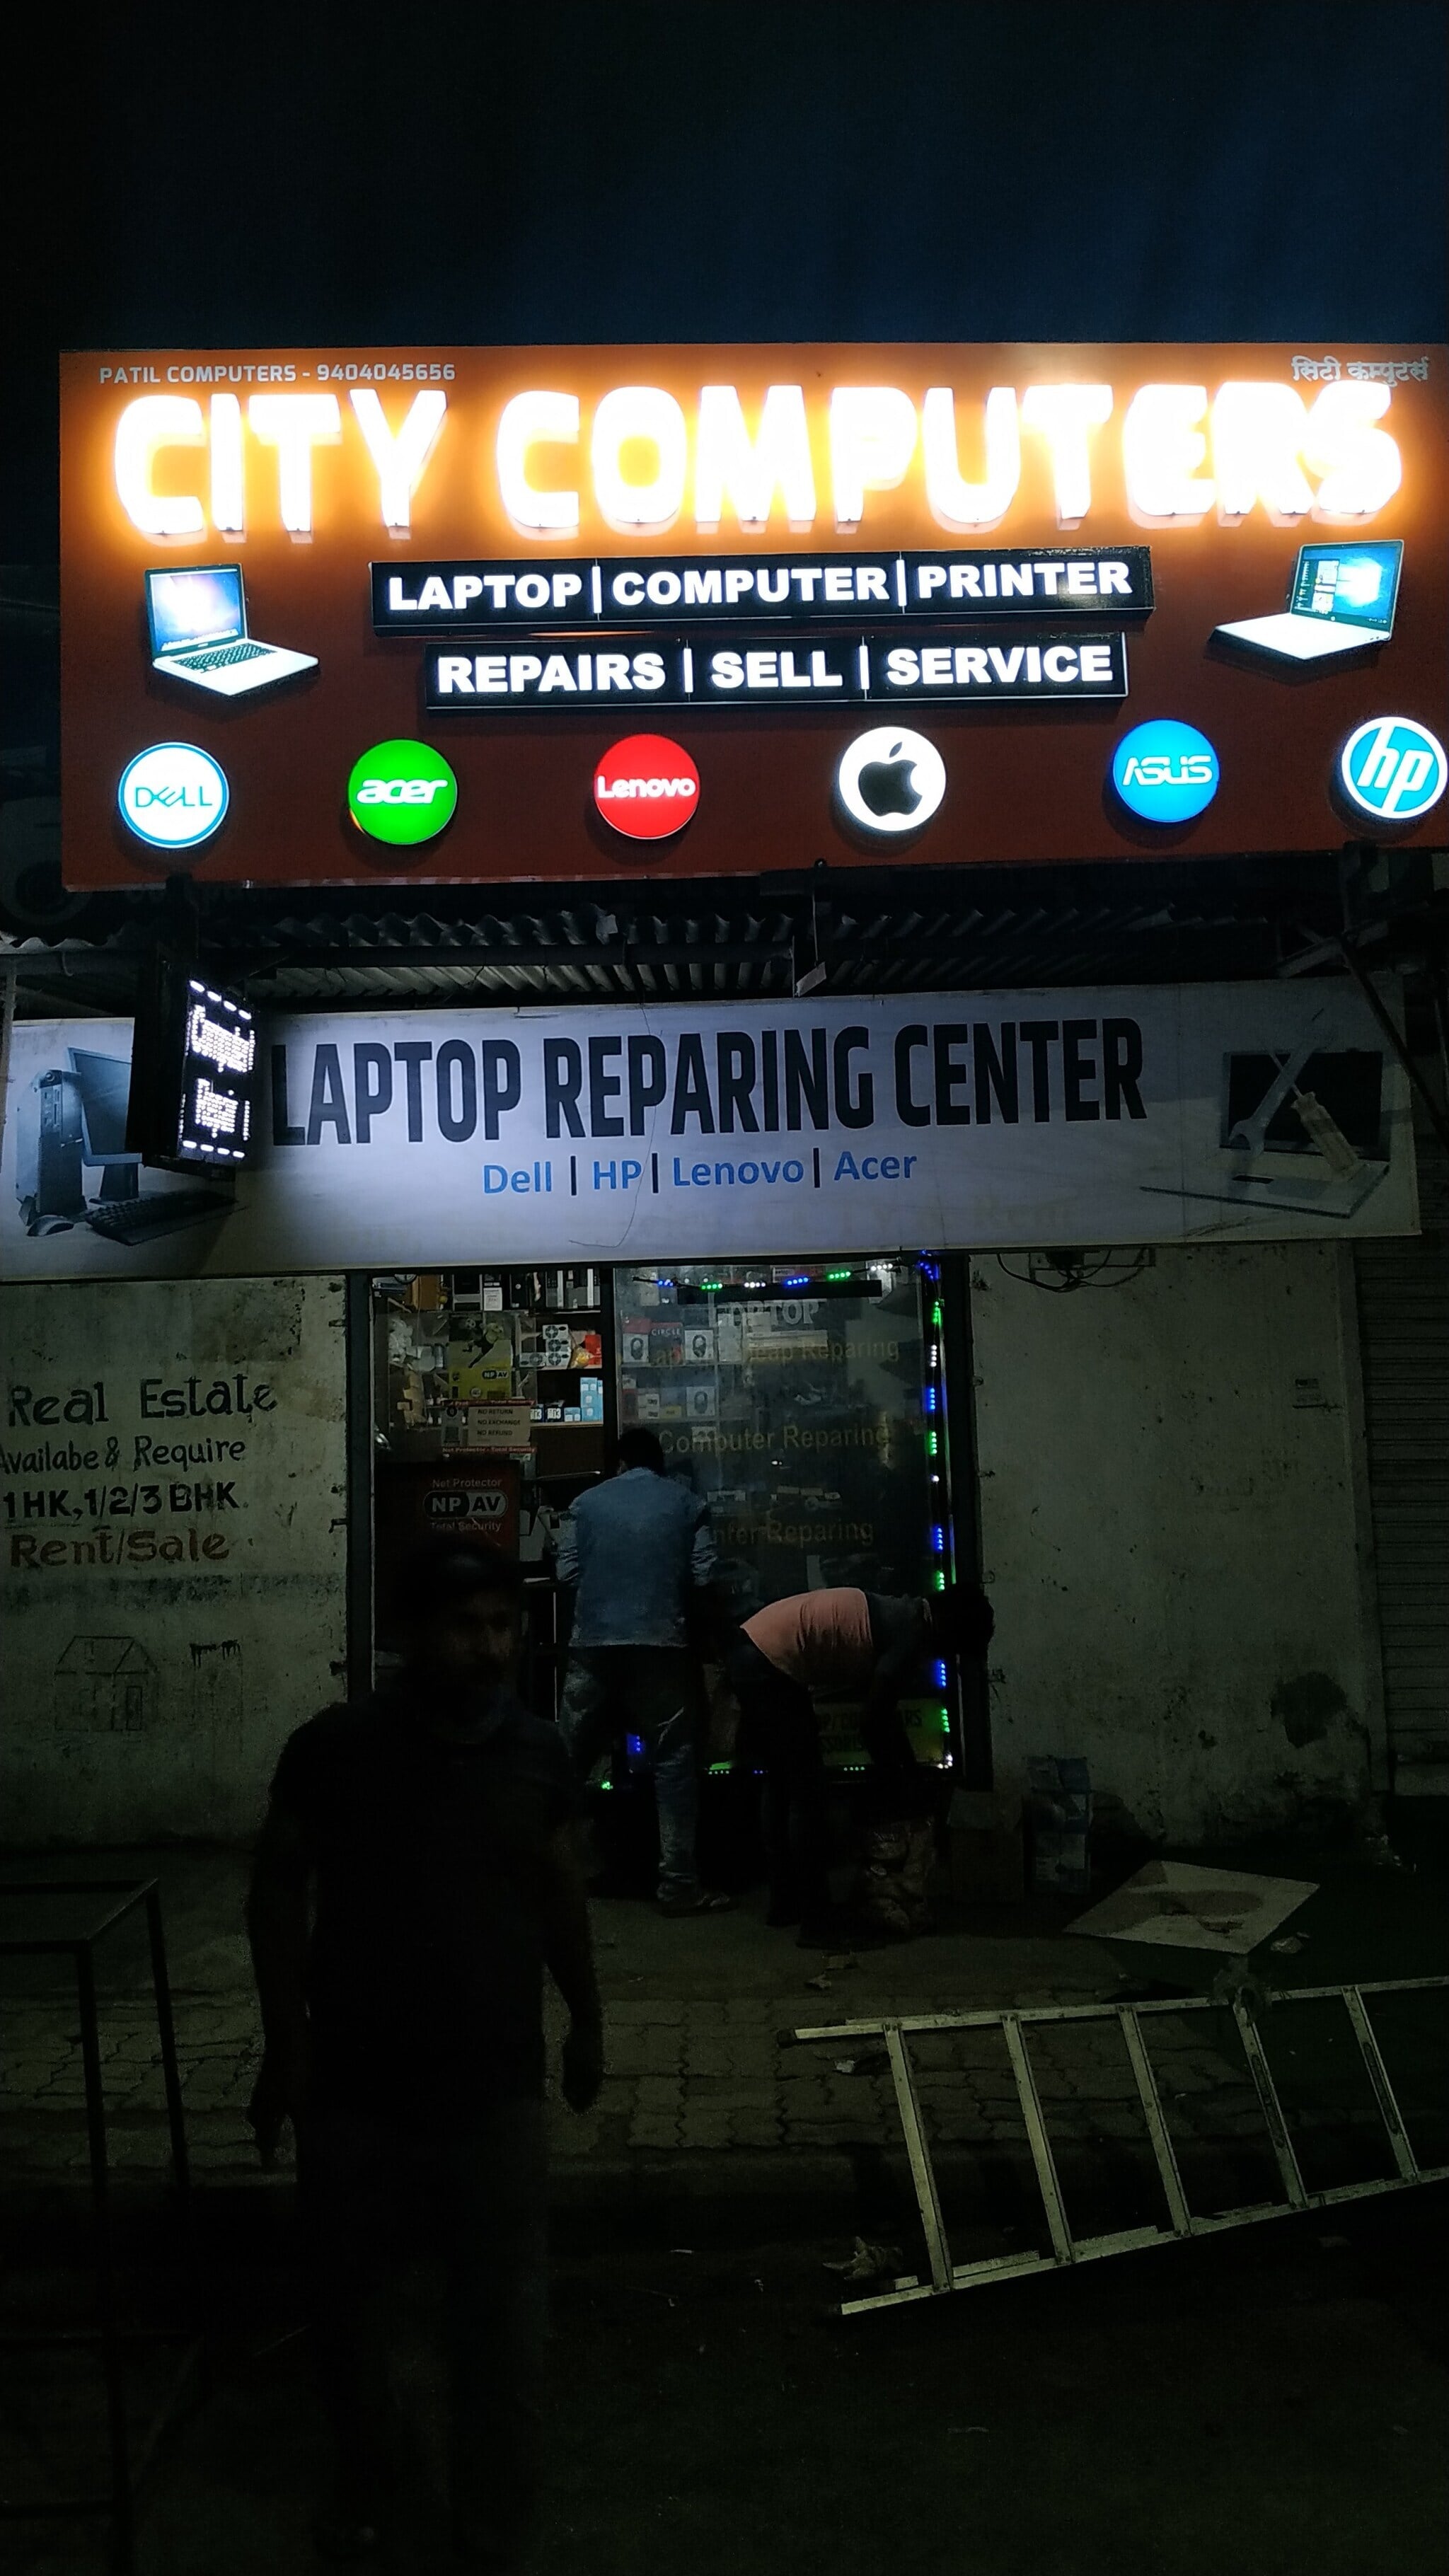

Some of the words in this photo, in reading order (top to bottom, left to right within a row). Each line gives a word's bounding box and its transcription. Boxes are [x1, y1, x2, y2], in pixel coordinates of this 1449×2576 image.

[100, 366, 161, 384] PATIL
[167, 364, 296, 383] COMPUTERS
[317, 363, 456, 381] 9404045656
[1291, 354, 1342, 381] सिटी
[115, 388, 447, 539] CITY
[497, 381, 1402, 532] COMPUTERS
[388, 573, 582, 611] LAPTOP
[612, 566, 890, 606] COMPUTER
[918, 561, 1133, 599] PRINTER
[437, 652, 666, 693] REPAIRS
[711, 649, 843, 689] SELL
[887, 645, 1113, 686] SERVICE
[1122, 755, 1213, 786] ASUS
[1356, 723, 1435, 814] hp
[134, 785, 213, 809] DELL
[357, 778, 449, 804] acer
[597, 775, 696, 799] Lenovo
[272, 1038, 522, 1146] LAPTOP
[543, 1025, 875, 1139] REPARING
[894, 1017, 1148, 1127] CENTER
[483, 1161, 553, 1194] Dell
[593, 1159, 642, 1190] HP
[673, 1156, 805, 1187] Lenovo
[833, 1150, 918, 1181] Acer
[8, 1381, 109, 1427] Real
[140, 1373, 278, 1419] Estate
[134, 1435, 246, 1472] Require
[659, 1427, 775, 1456] Computer
[170, 1481, 239, 1513] BHK
[432, 1479, 450, 1488] Net
[453, 1478, 503, 1488] Protector
[458, 1520, 502, 1532] Security
